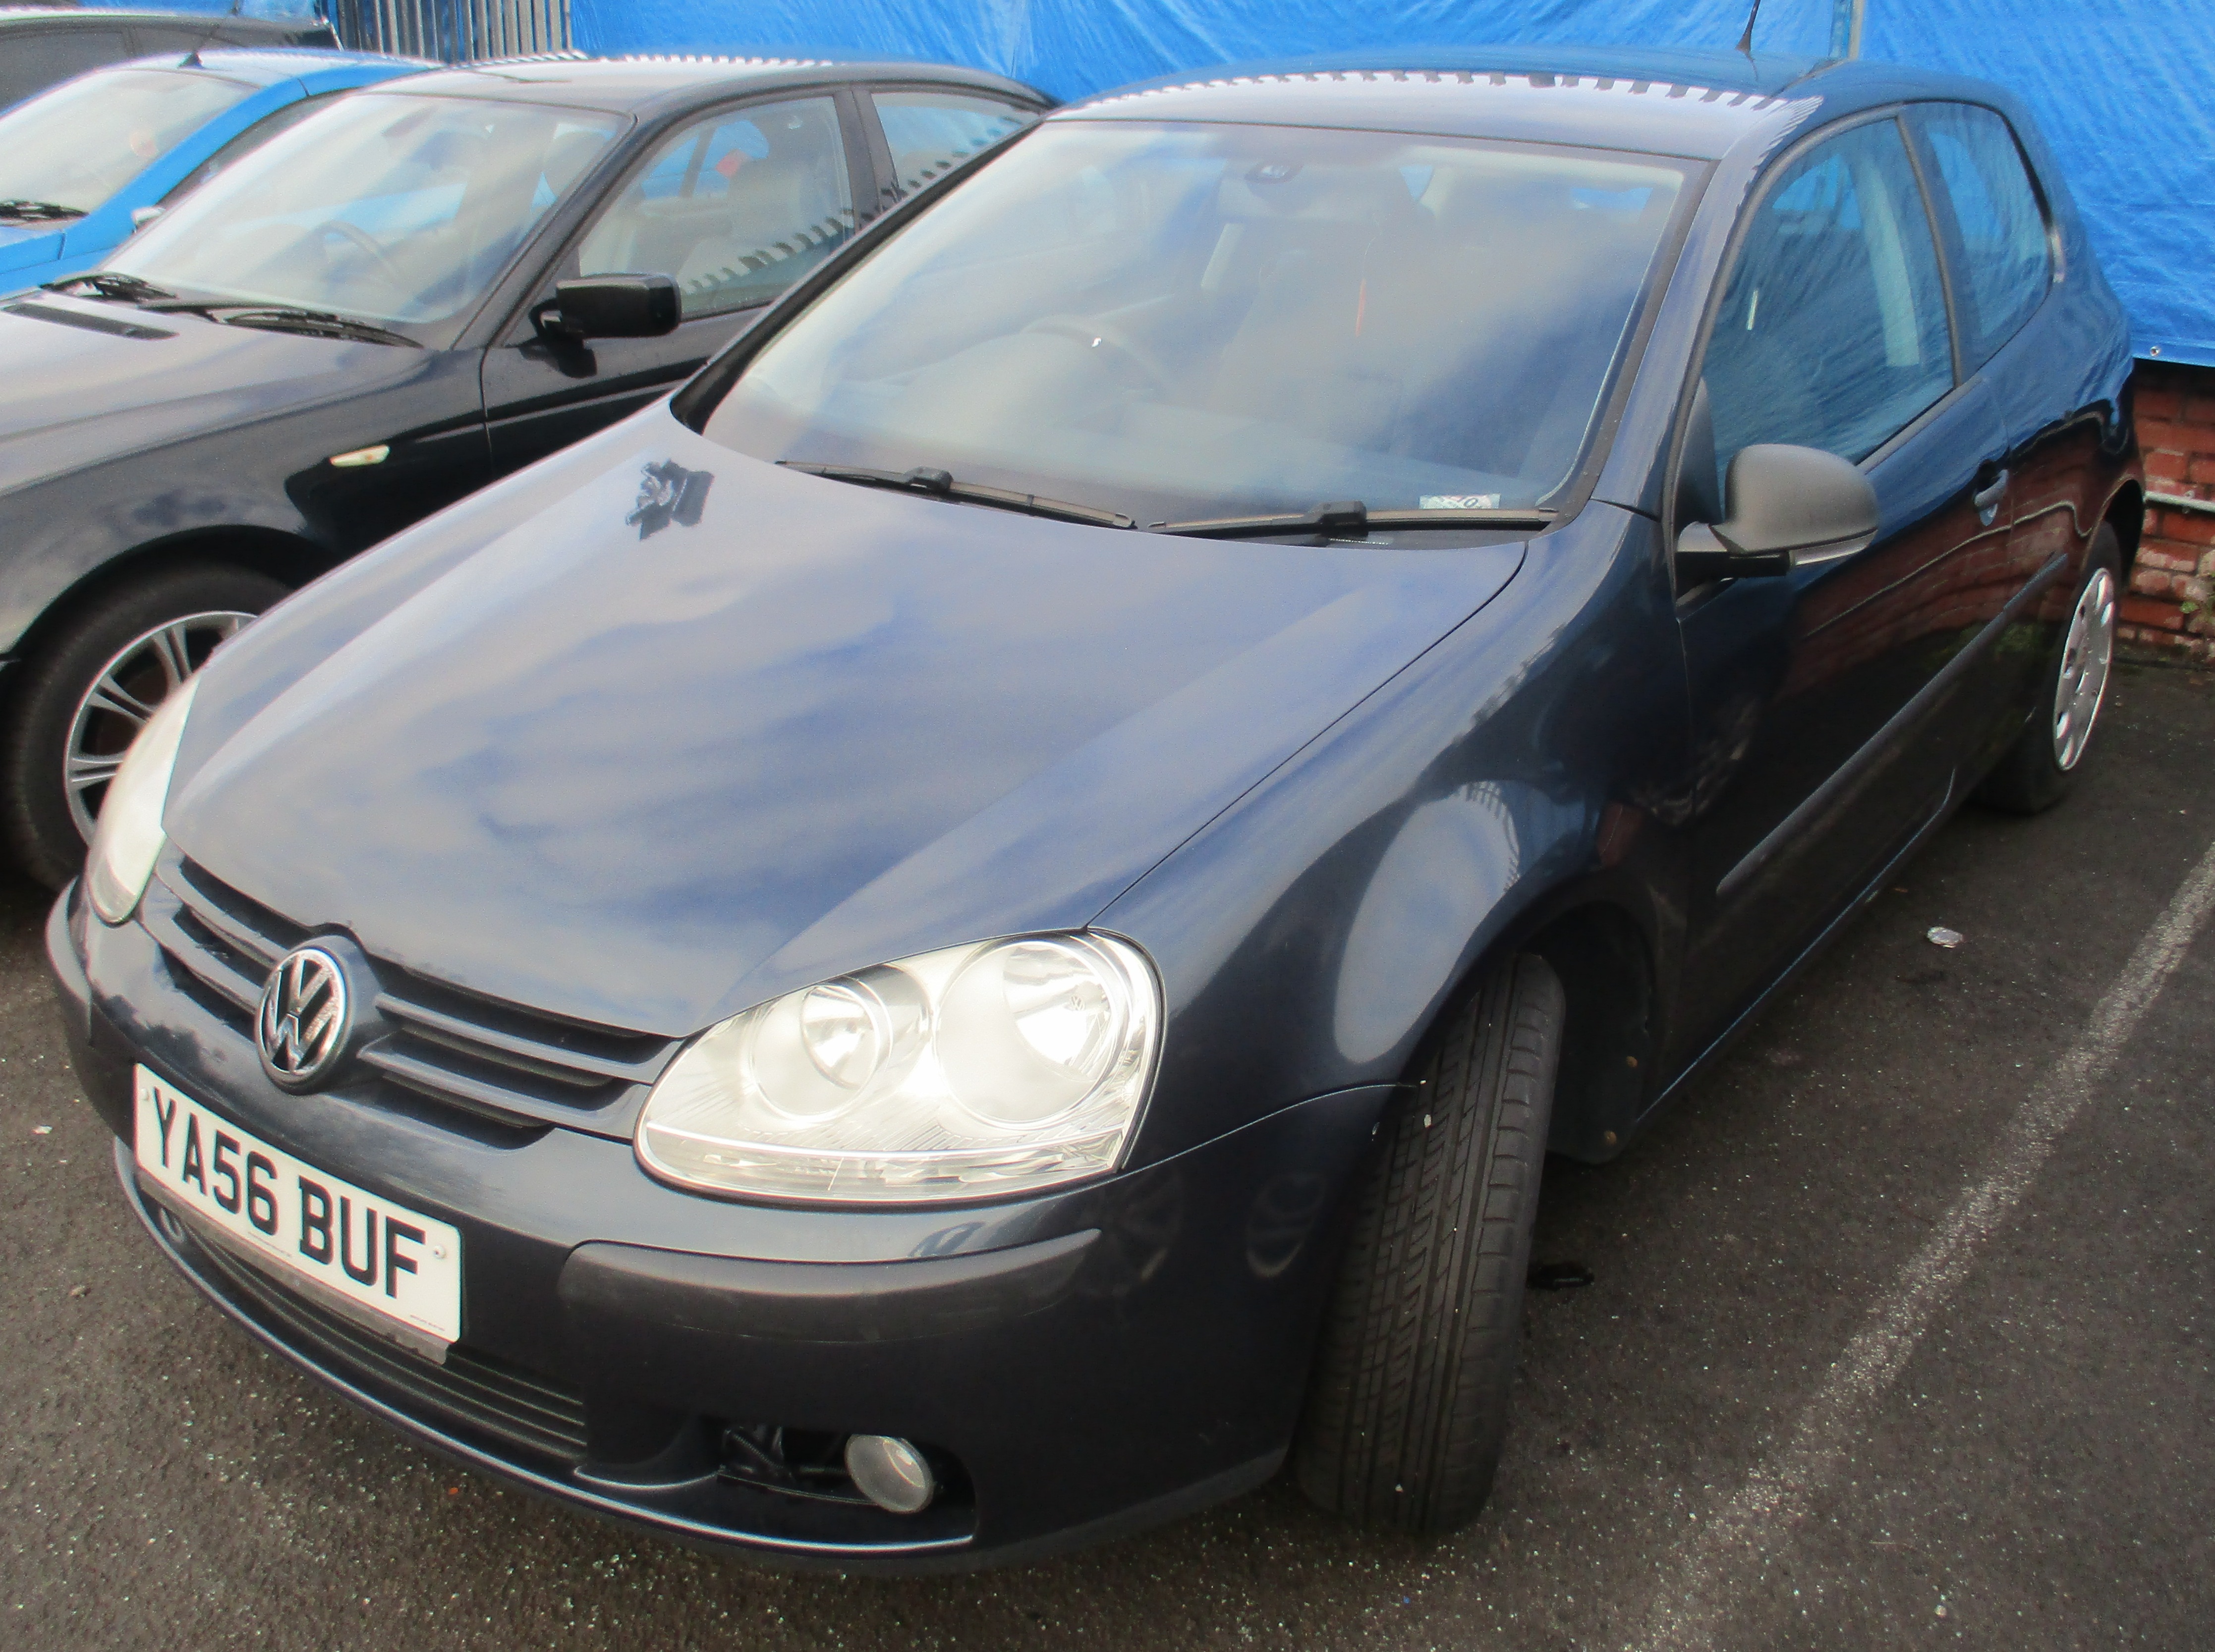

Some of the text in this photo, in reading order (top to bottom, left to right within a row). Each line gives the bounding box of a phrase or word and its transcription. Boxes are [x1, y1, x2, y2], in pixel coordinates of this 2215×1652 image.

[257, 949, 347, 1076] VW
[154, 1086, 426, 1299] YA56 BUF
